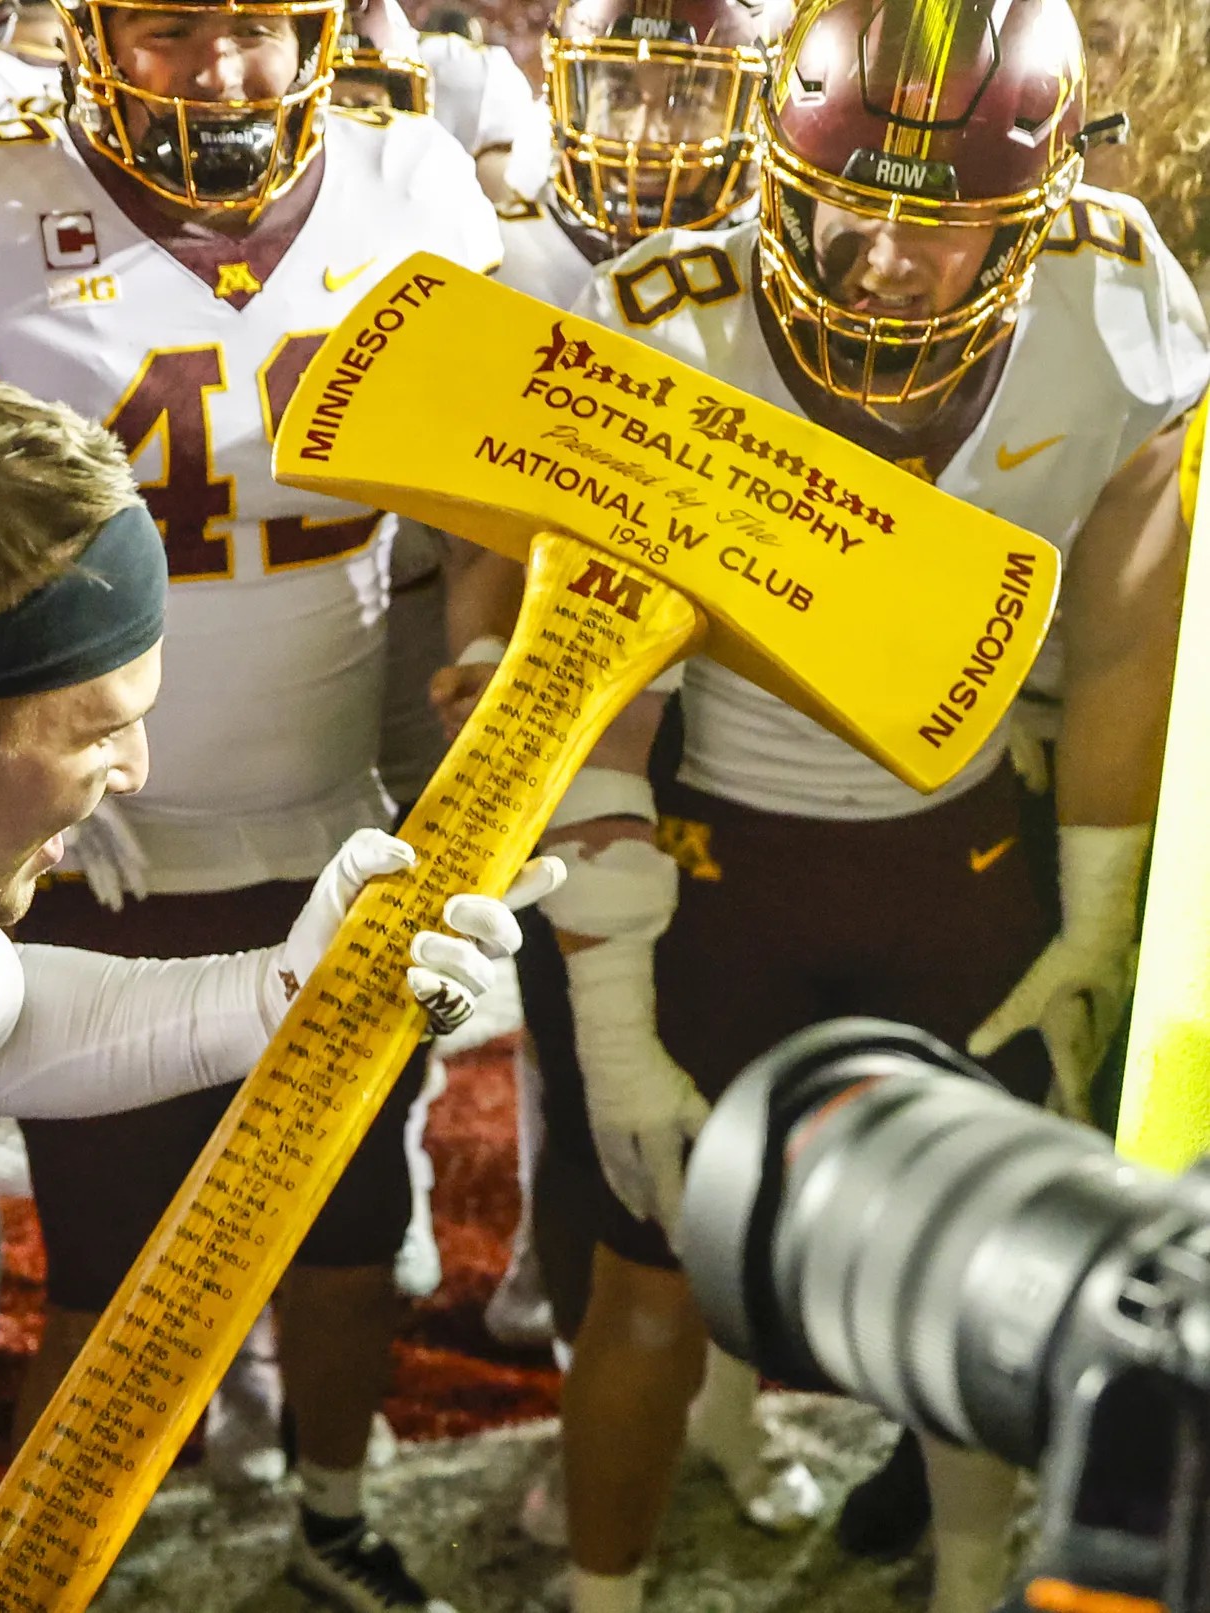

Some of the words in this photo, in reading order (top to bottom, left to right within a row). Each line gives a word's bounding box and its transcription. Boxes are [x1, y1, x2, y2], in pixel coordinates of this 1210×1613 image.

[876, 159, 927, 189] ROW
[42, 213, 98, 267] C
[215, 260, 262, 298] M
[613, 246, 743, 329] 8
[300, 271, 446, 463] MINNESOTA
[530, 320, 677, 408] Paul
[690, 394, 897, 537] Bunyan
[474, 434, 651, 530] NATIONAL
[667, 516, 710, 551] W
[718, 546, 815, 614] CLUB
[521, 378, 713, 477] FOOTBALL
[726, 464, 865, 556] TROPHY
[539, 423, 658, 490] Presented
[663, 481, 707, 510] by
[715, 506, 785, 548] The
[608, 522, 669, 566] 1948
[919, 551, 1036, 750] WISCONSIN
